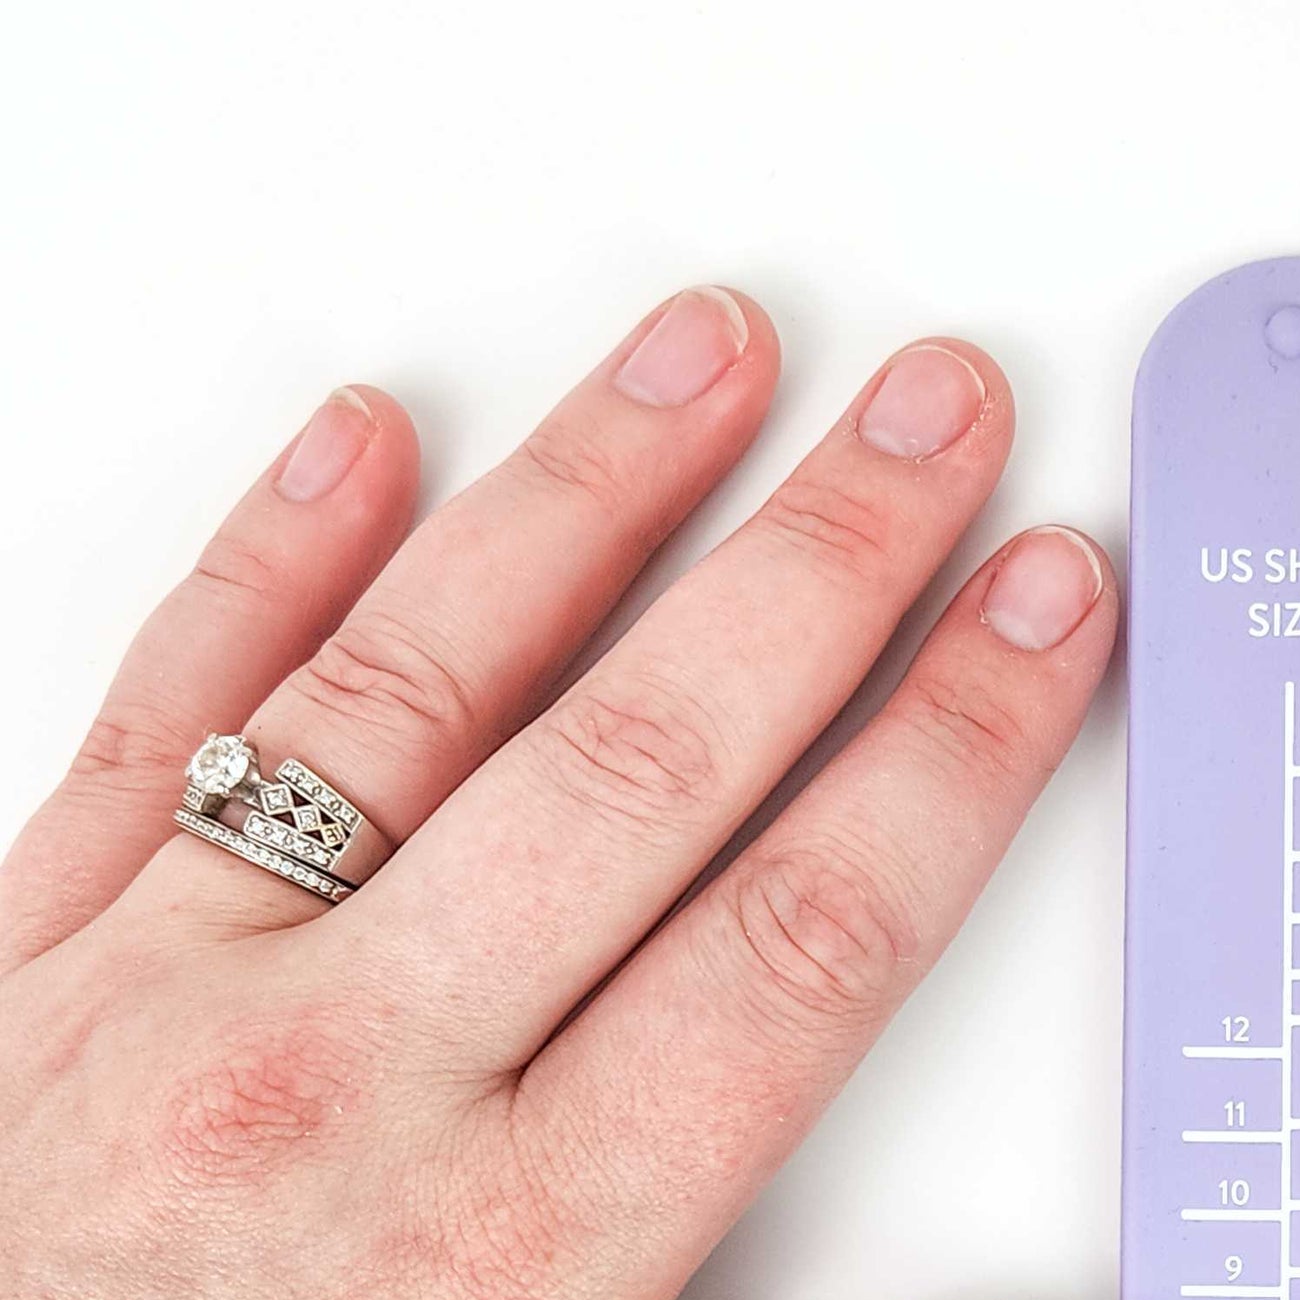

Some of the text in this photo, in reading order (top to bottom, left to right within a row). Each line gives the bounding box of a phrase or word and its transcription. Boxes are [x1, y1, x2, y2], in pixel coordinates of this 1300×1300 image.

[1200, 546, 1254, 584] US
[1221, 1015, 1251, 1042] 12
[1223, 1100, 1245, 1127] 11
[1217, 1179, 1251, 1206] 10
[1224, 1255, 1243, 1282] 9
